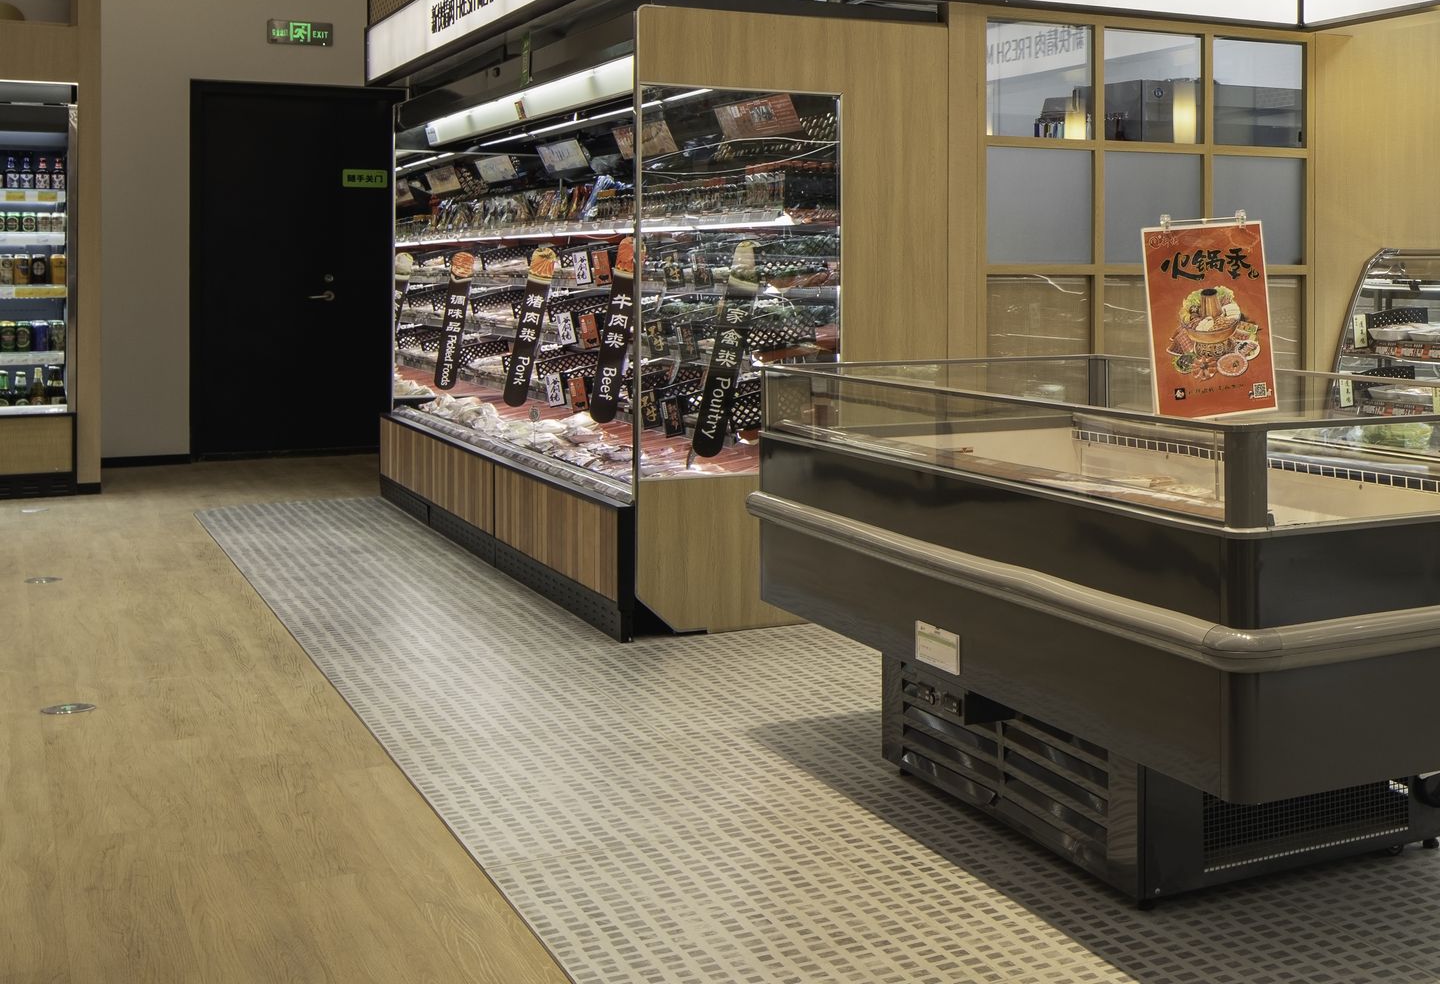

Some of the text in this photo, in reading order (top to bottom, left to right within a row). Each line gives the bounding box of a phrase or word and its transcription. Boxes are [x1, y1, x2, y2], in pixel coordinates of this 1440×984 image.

[312, 30, 329, 39] EXIT
[1160, 247, 1252, 282] 火锅季
[445, 294, 465, 334] 调味品
[715, 307, 749, 368] 家禽类
[513, 294, 544, 386] 猪肉类 Pork
[599, 294, 633, 401] 牛肉类 Beef
